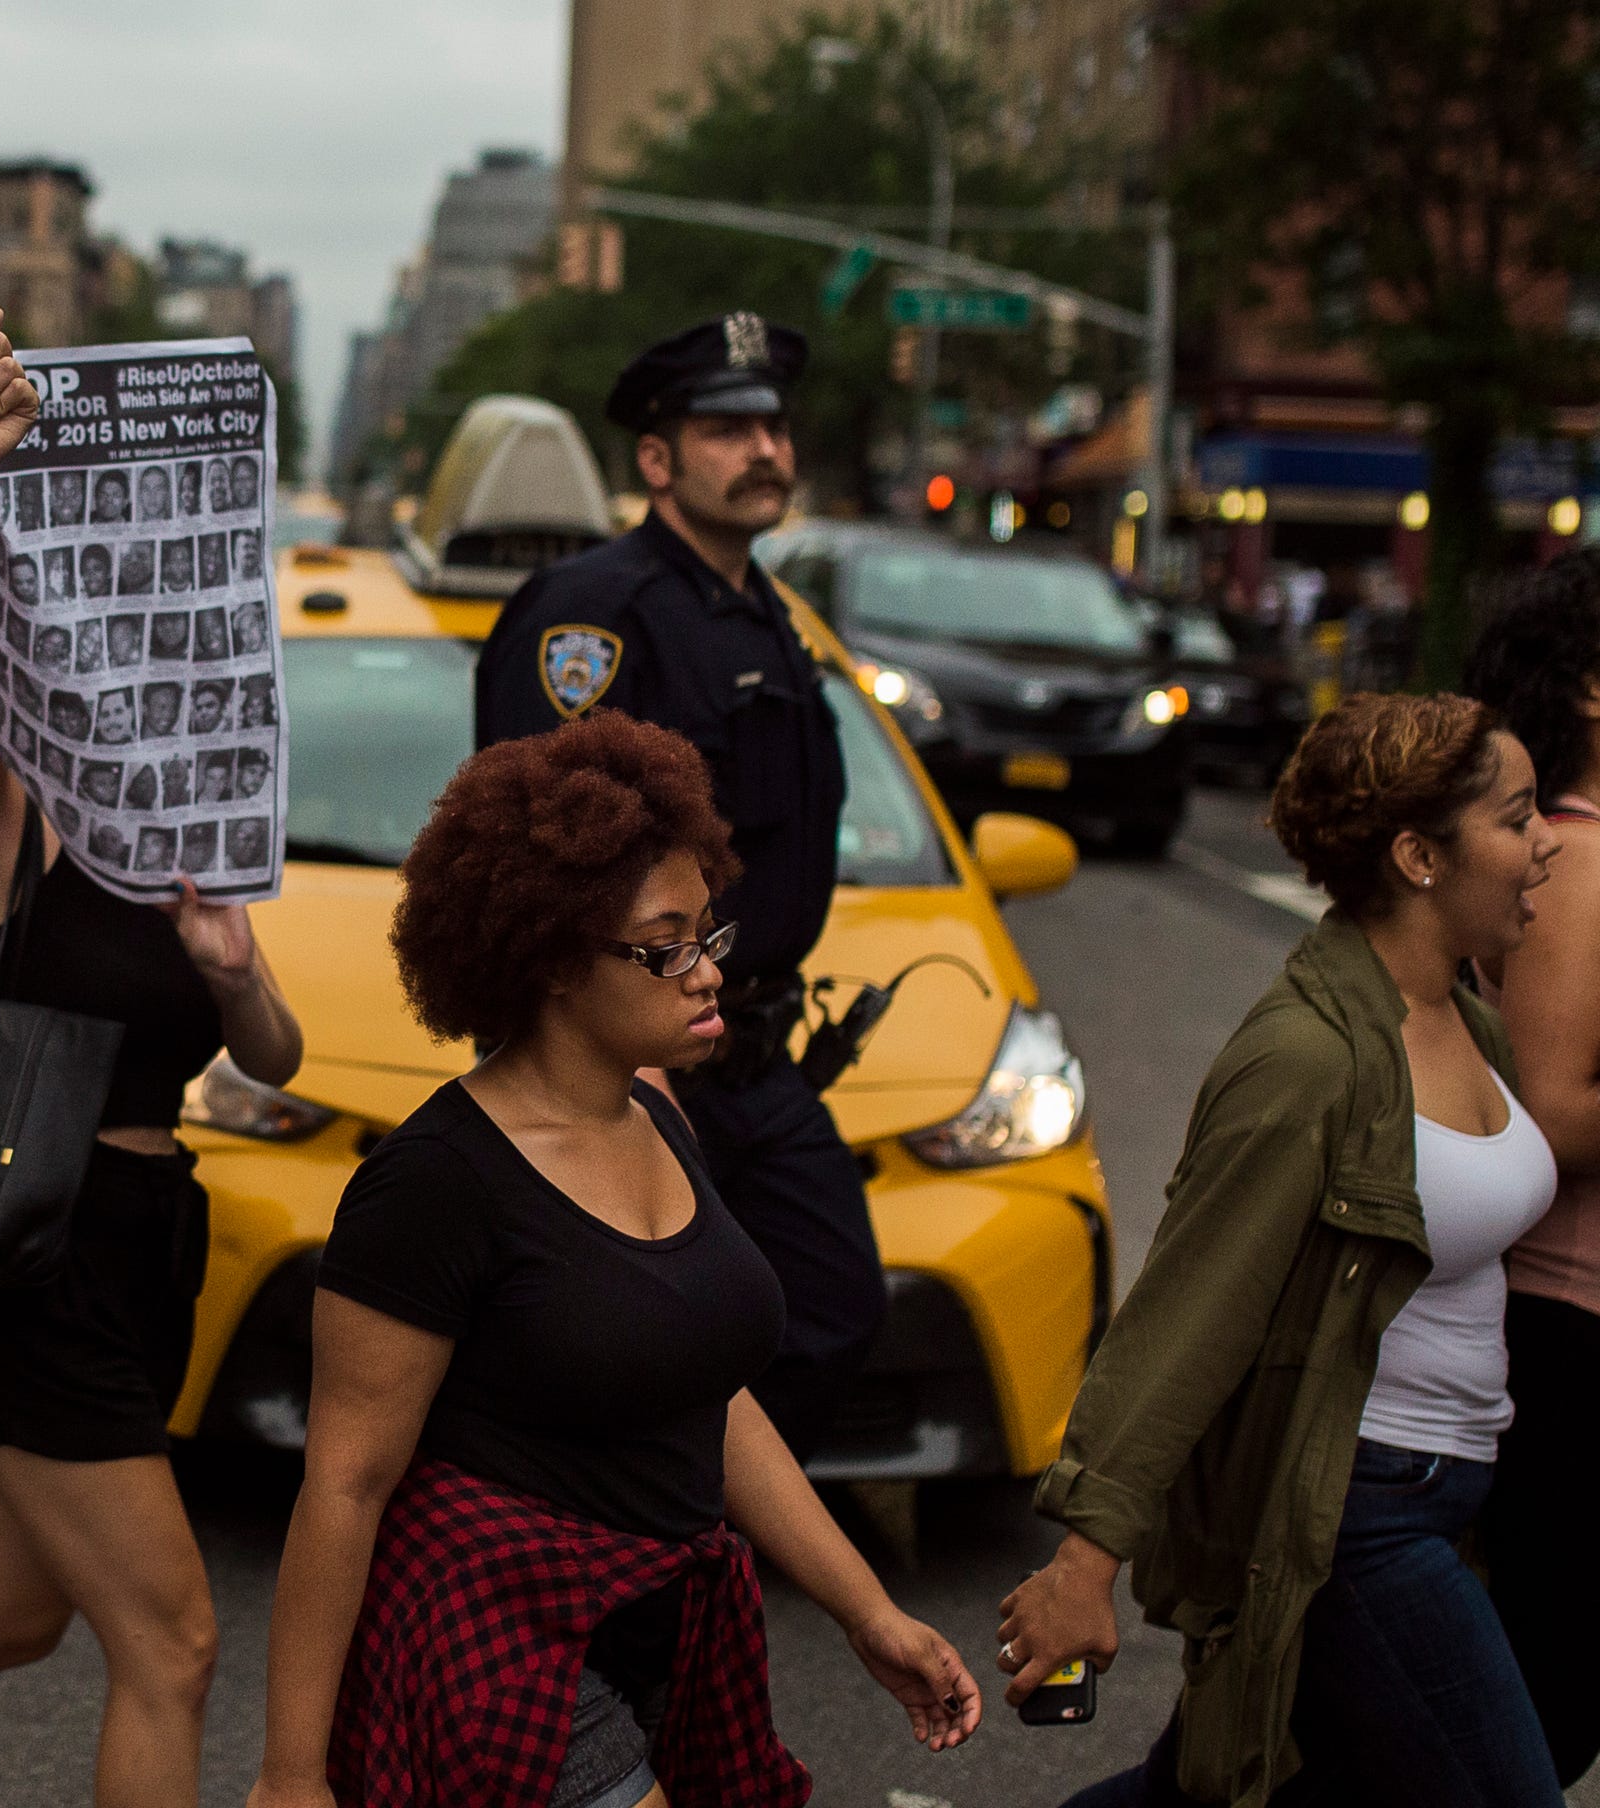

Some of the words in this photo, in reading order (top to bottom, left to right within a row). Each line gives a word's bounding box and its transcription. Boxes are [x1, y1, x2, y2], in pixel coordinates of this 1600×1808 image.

[22, 369, 81, 404] OP
[117, 360, 260, 387] #RiseUpOctober
[36, 395, 108, 420] RROR
[118, 390, 157, 409] Which
[159, 387, 187, 406] Side
[189, 386, 211, 403] Are
[213, 384, 233, 401] You
[235, 382, 260, 400] On?
[57, 421, 114, 447] 2015
[120, 418, 167, 442] New
[171, 412, 215, 438] York
[220, 409, 260, 436] City
